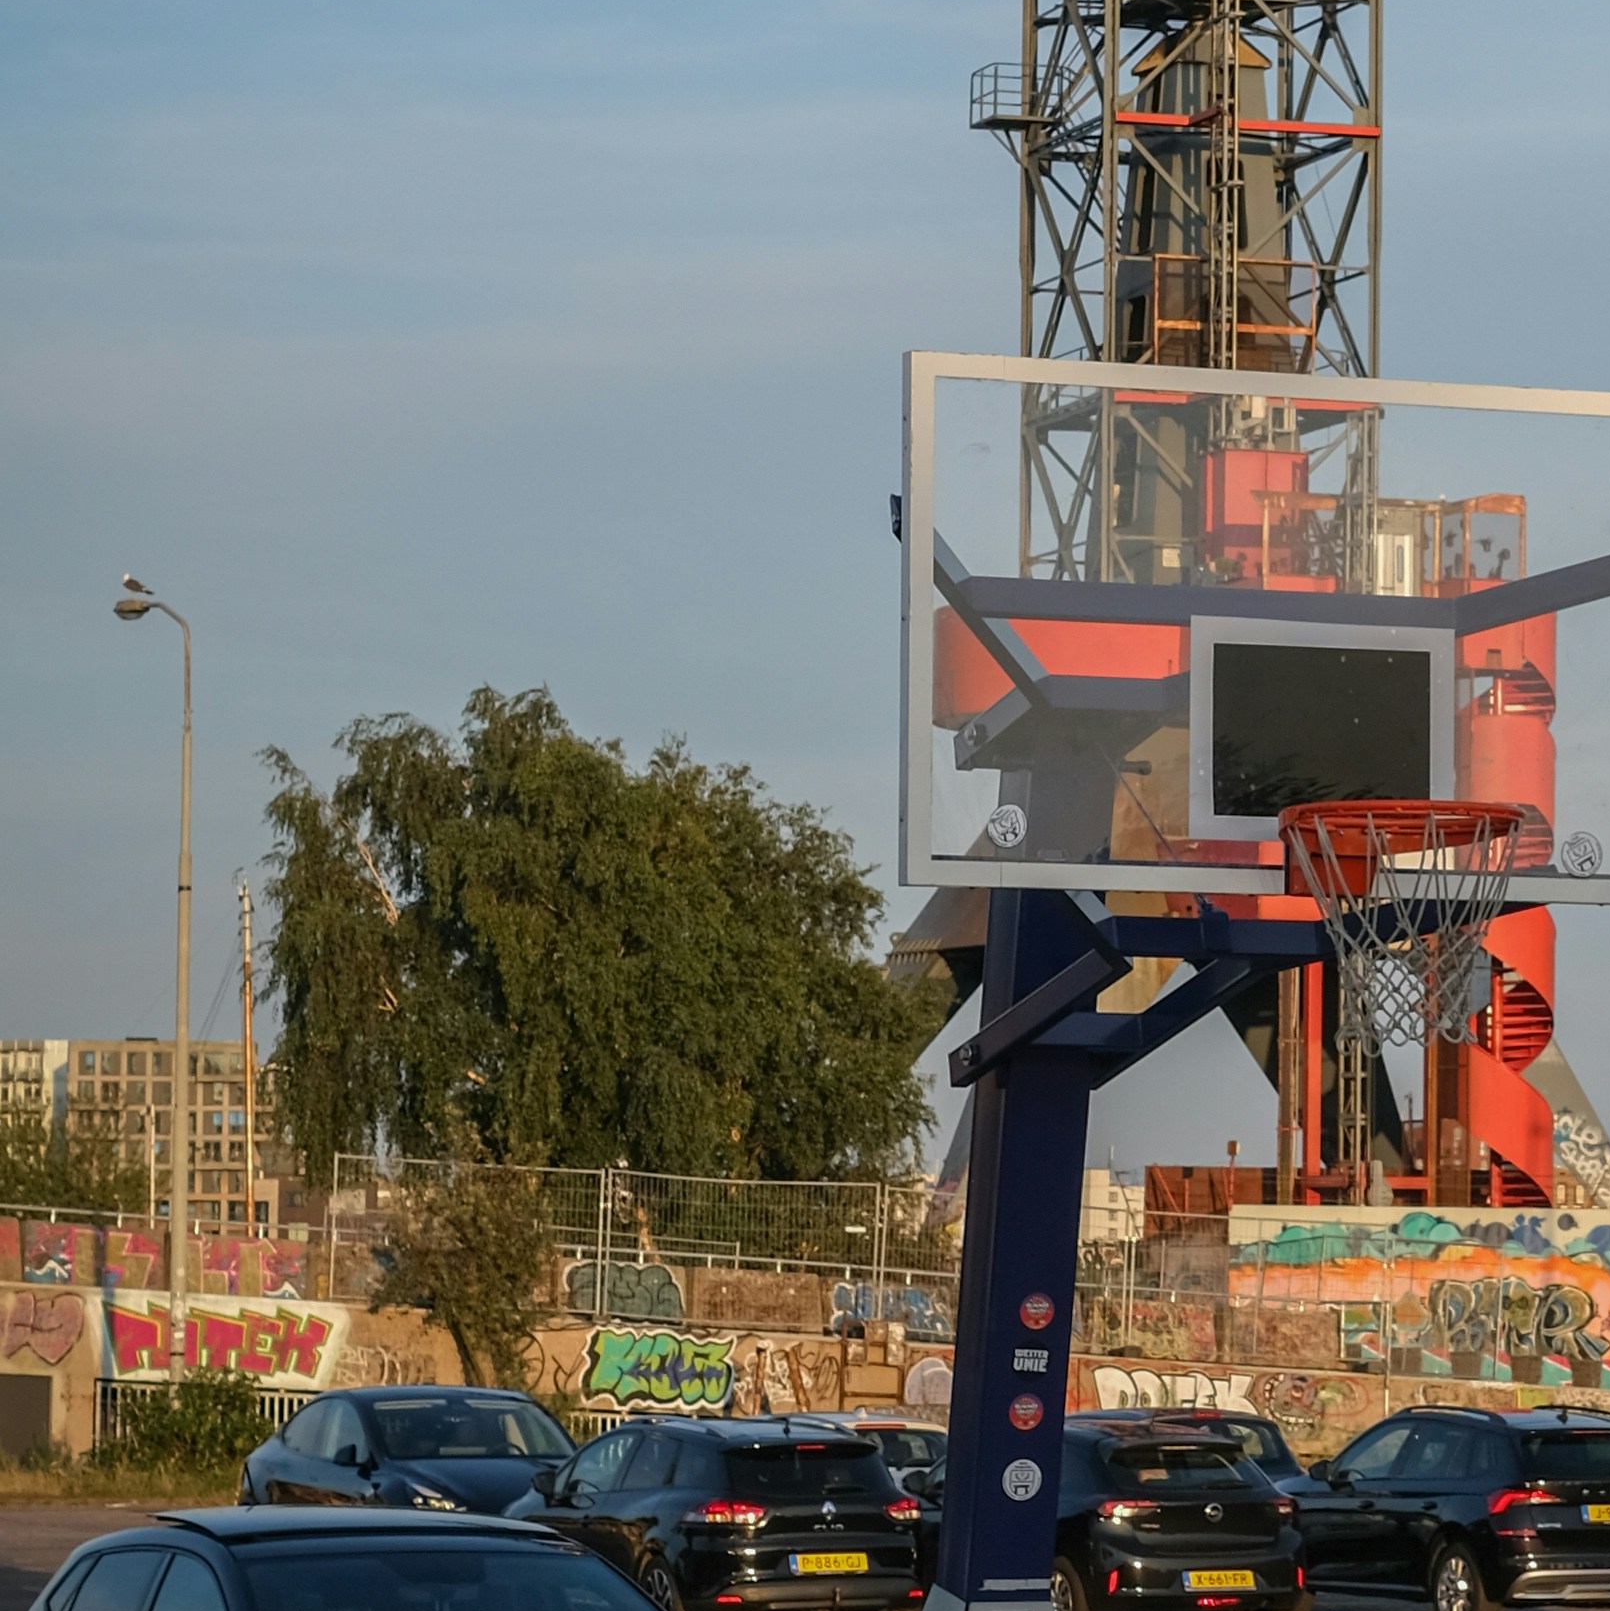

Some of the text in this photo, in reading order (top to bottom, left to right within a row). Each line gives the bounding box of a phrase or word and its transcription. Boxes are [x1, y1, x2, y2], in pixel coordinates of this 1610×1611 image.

[1013, 1357, 1048, 1372] UNIE
[801, 1556, 861, 1569] P-886-GJ
[1195, 1573, 1248, 1586] X-661-FR
